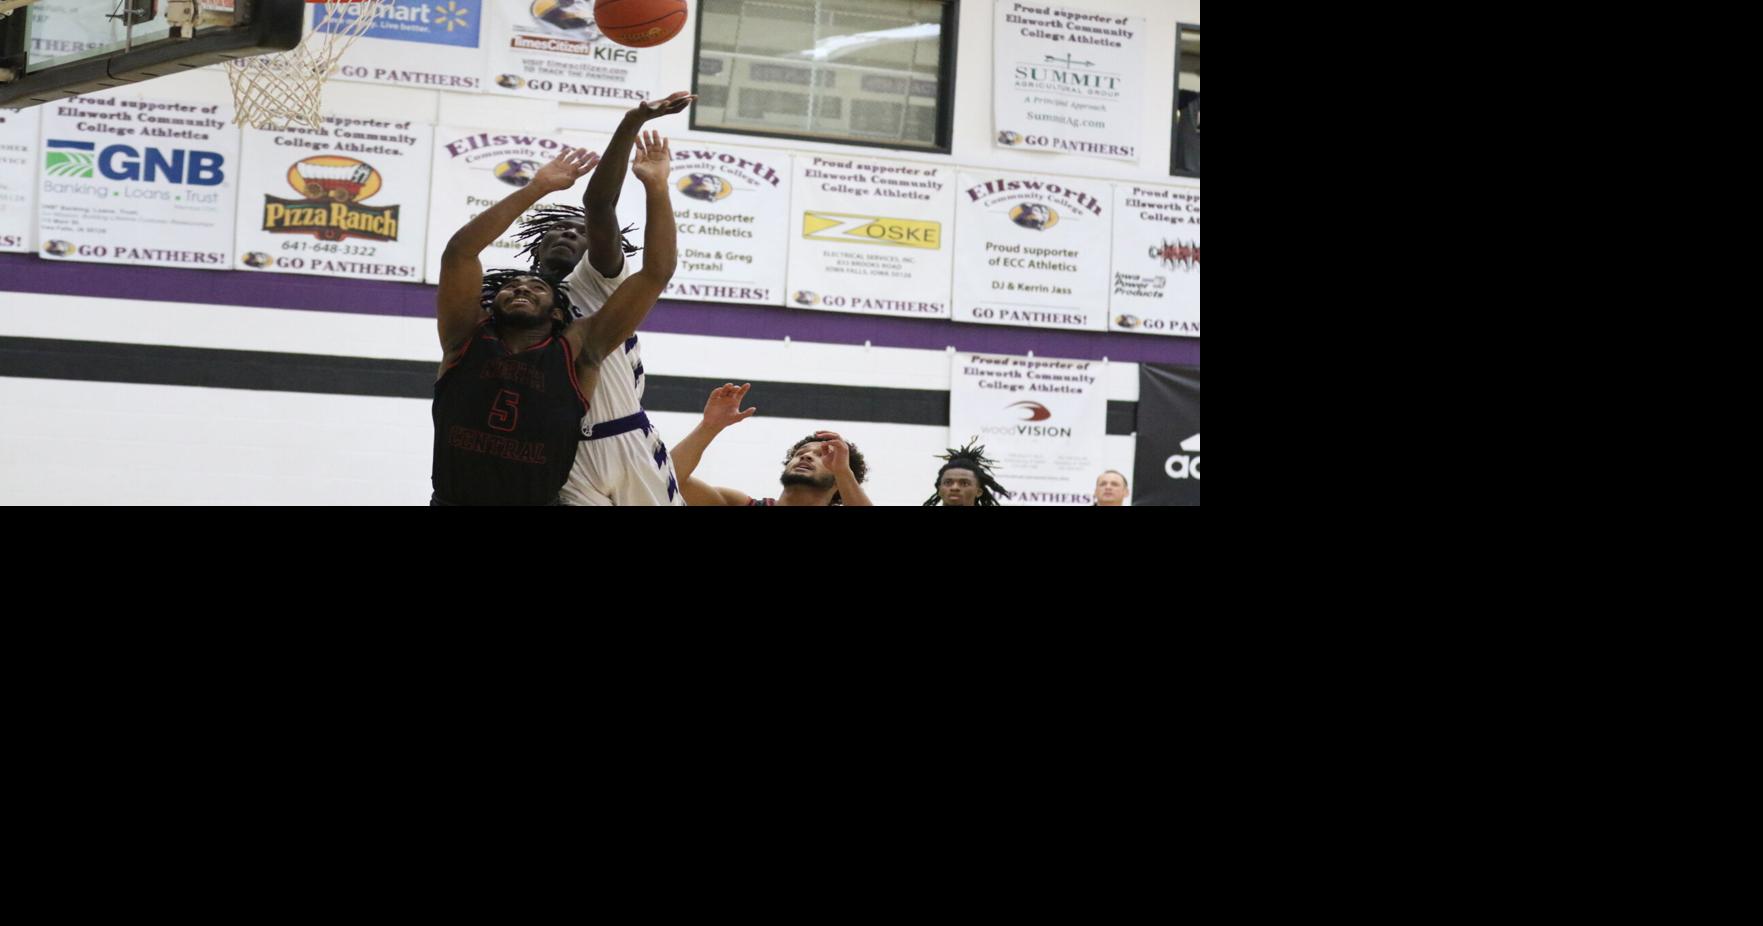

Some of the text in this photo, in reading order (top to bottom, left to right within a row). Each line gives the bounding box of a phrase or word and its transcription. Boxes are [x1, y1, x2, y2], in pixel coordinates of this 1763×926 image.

[1013, 3, 1128, 25] Proud supporter of
[1006, 14, 1134, 39] Ellsworth Community
[1020, 28, 1122, 48] College Athletics
[594, 46, 638, 63] KIFG
[341, 65, 480, 88] GO PANTHERS!
[1015, 67, 1121, 90] SUMMIT
[527, 79, 650, 101] GO PANTHERS!
[1014, 81, 1120, 97] AGRICULTURAL GROUP
[67, 95, 218, 115] Proud supporter of
[57, 107, 226, 130] Ellsworth Community
[395, 121, 411, 130] of
[1026, 112, 1106, 128] SummitAg.com
[76, 121, 209, 140] College Athletics
[334, 128, 417, 145] Community
[274, 136, 404, 156] College Athletics.
[1025, 135, 1135, 157] GO PANTHERS!
[98, 144, 225, 186] GNB
[465, 149, 536, 163] Community
[719, 166, 761, 186] College
[813, 157, 938, 177] Proud supporter of
[805, 169, 944, 191] Ellsworth Community
[43, 180, 218, 204] Banking Loans Trust
[821, 183, 930, 201] College Athletics
[965, 178, 1102, 216] Ellsworth
[1133, 187, 1169, 198] Proud
[984, 192, 1084, 216] Community College
[1125, 199, 1182, 212] Ellsworth
[265, 203, 396, 238] Pizza Ranch
[693, 213, 755, 224] supporter
[1140, 212, 1184, 224] College
[698, 225, 753, 238] Athletics
[806, 213, 937, 243] ZOSKE
[78, 244, 225, 264] GO PANTHERS!
[281, 240, 376, 257] 641-648-3322
[685, 249, 711, 259] Dina
[714, 251, 723, 259] &
[725, 252, 753, 263] Greg
[985, 242, 1079, 259] Proud supporter
[276, 257, 416, 277] GO PANTHERS!
[681, 260, 724, 272] Tystahl
[988, 257, 1078, 272] of ECC Athletics
[1115, 271, 1140, 280] Iowa
[1115, 278, 1148, 289] Power
[663, 282, 770, 300] PANTHERS!
[991, 281, 1072, 295] DJ & Kerrin Jass
[1114, 287, 1164, 298] Products
[822, 295, 945, 314] GO PANTHERS!
[972, 307, 1088, 326] GO PANTHERS!
[1143, 319, 1165, 330] GO
[971, 354, 1090, 371] Proud supporter of
[964, 367, 1096, 384] Ellsworth Community
[978, 380, 1083, 394] College Athletics
[487, 388, 520, 432] 5
